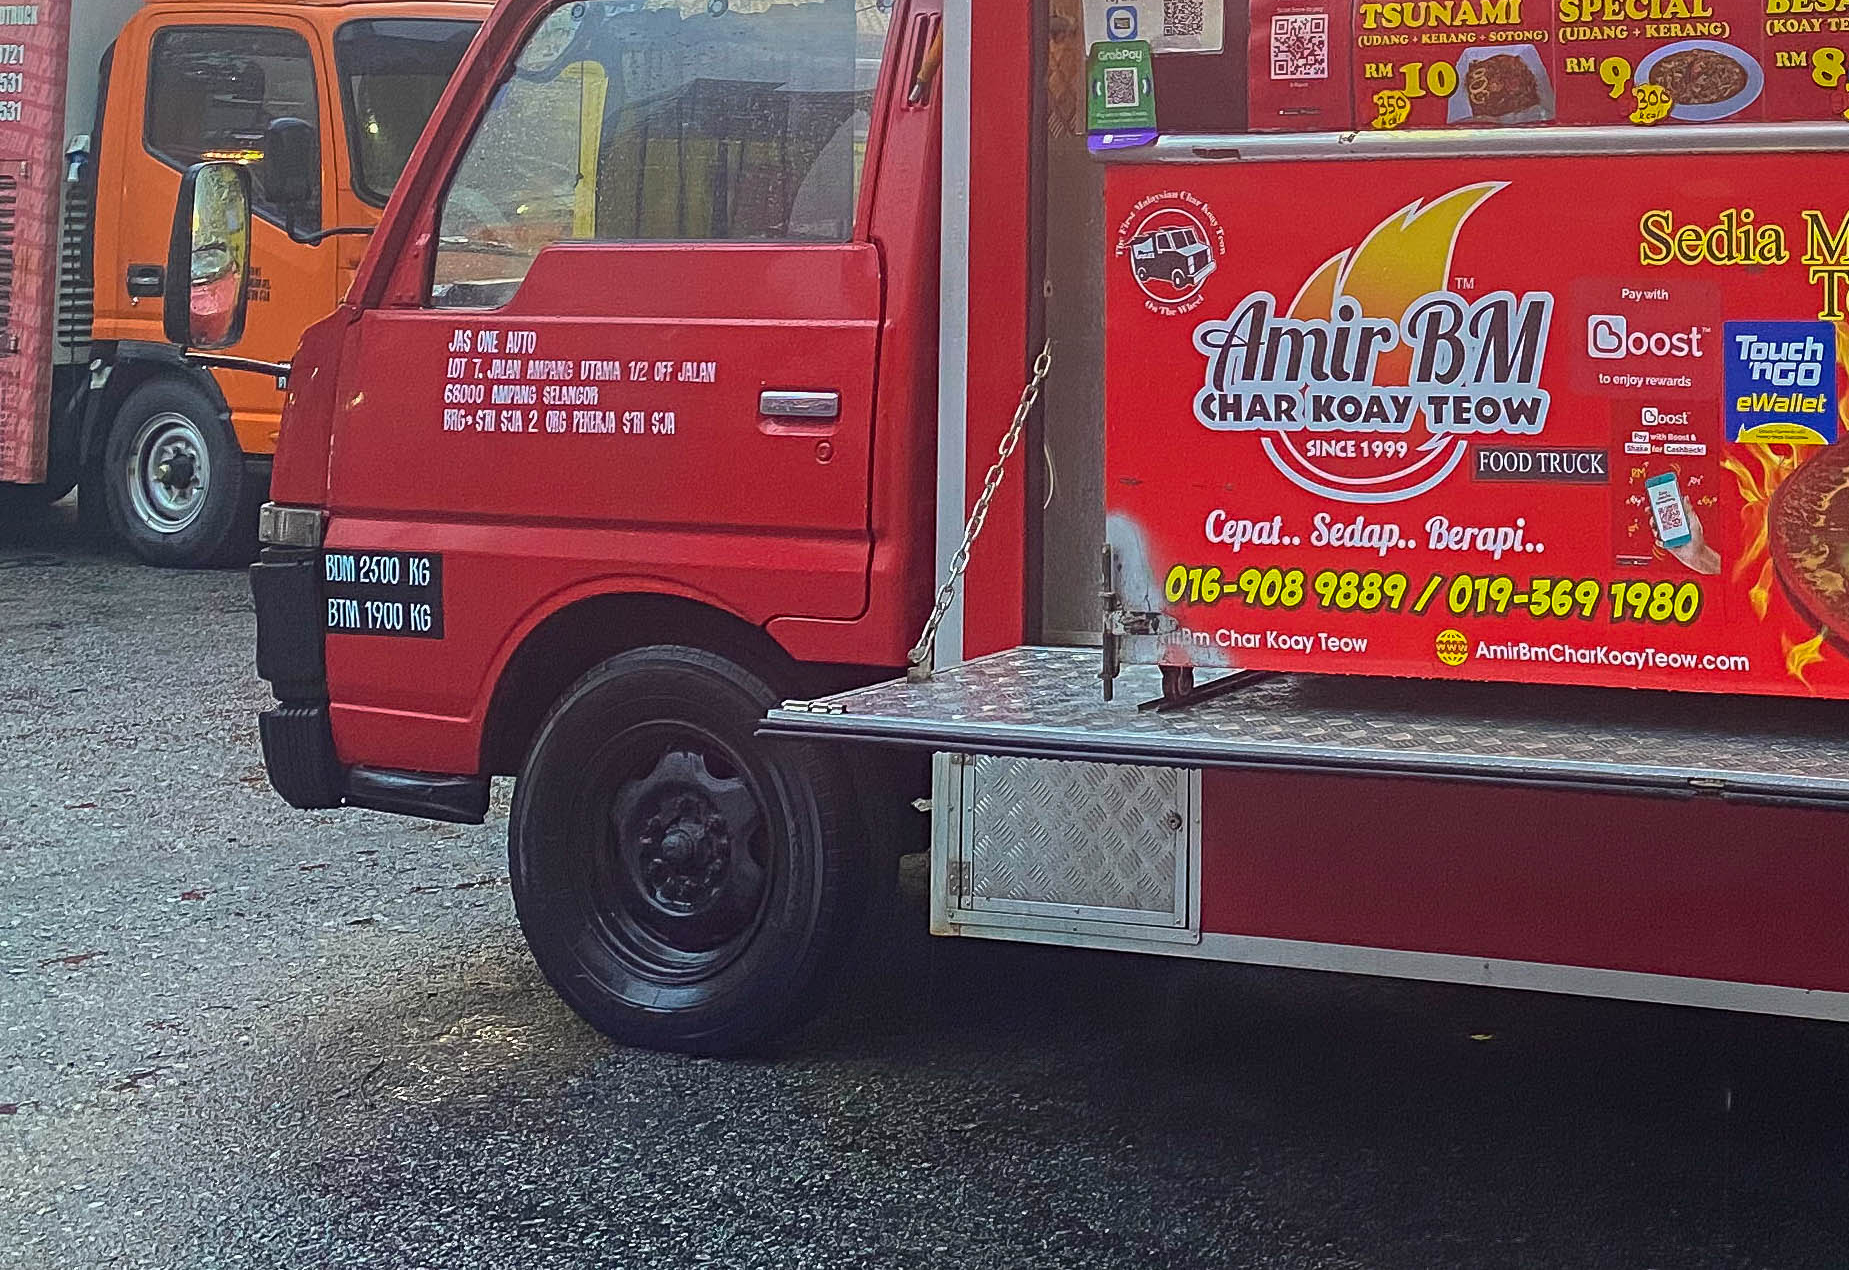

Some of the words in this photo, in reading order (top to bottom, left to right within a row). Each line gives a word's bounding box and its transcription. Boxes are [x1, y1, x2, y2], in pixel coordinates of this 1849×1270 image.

[1358, 34, 1409, 48] (UDANG
[1421, 32, 1476, 44] KERANG
[1488, 30, 1549, 43] SOTONG)
[1558, 26, 1629, 44] (UDANG
[1645, 22, 1731, 38] KERANG)
[1766, 18, 1823, 36] (KOAY
[1097, 49, 1143, 63] GrabPay
[1775, 51, 1807, 67] RM
[1811, 46, 1846, 88] 8
[1364, 62, 1393, 79] RM
[1399, 61, 1457, 98] 10
[1565, 57, 1596, 73] RM
[1599, 56, 1632, 99] 9
[1640, 208, 1789, 266] Sedia
[1621, 288, 1642, 303] Pay
[1643, 288, 1669, 301] with
[448, 330, 472, 353] JAS
[477, 330, 499, 354] ONE
[505, 331, 537, 354] AUTO
[1199, 299, 1393, 390] Amir
[1408, 299, 1547, 386] BM
[1587, 314, 1704, 359] Boost
[1736, 335, 1824, 361] Touch
[446, 357, 468, 379] LOT
[487, 359, 522, 380] JALAN
[526, 360, 574, 381] AMPANG
[580, 360, 621, 381] UTAMA
[628, 361, 649, 381] 1/2
[653, 361, 675, 382] OFF
[677, 361, 716, 383] JALAN
[1598, 373, 1611, 385] to
[1612, 374, 1644, 389] enjoy
[1645, 375, 1692, 388] rewards
[444, 383, 485, 404] 68000
[491, 385, 537, 405] AMPANG
[542, 385, 599, 406] SELANGOR
[1736, 392, 1827, 414] eWallet
[527, 409, 539, 433] 2
[545, 410, 567, 433] ORG
[572, 410, 616, 433] PEKERJA
[1201, 392, 1298, 423] CHAR
[1312, 393, 1413, 424] KOAY
[1427, 395, 1542, 426] TEOW
[1305, 439, 1358, 458] SINCE
[1360, 440, 1408, 460] 1999
[1478, 451, 1533, 474] FOOD
[1537, 452, 1605, 475] TRUCK
[1205, 509, 1301, 553] Cepat..
[1310, 512, 1417, 558] Sedap..
[1424, 515, 1545, 560] Berapi..
[325, 554, 355, 582] BDM
[359, 555, 400, 585] 2500
[408, 557, 430, 586] KG
[1164, 565, 1304, 607] 016-908
[1314, 571, 1407, 610] 9889
[1448, 574, 1600, 617] 019-369
[1610, 581, 1699, 622] 1980
[327, 598, 361, 628] BTM
[364, 600, 403, 631] 1900
[410, 602, 432, 632] KG
[1215, 628, 1261, 648] Char
[1266, 630, 1313, 654] Koay
[1317, 632, 1368, 653] Teow
[1474, 640, 1751, 671] AmirBmCharKoayTeow.com
